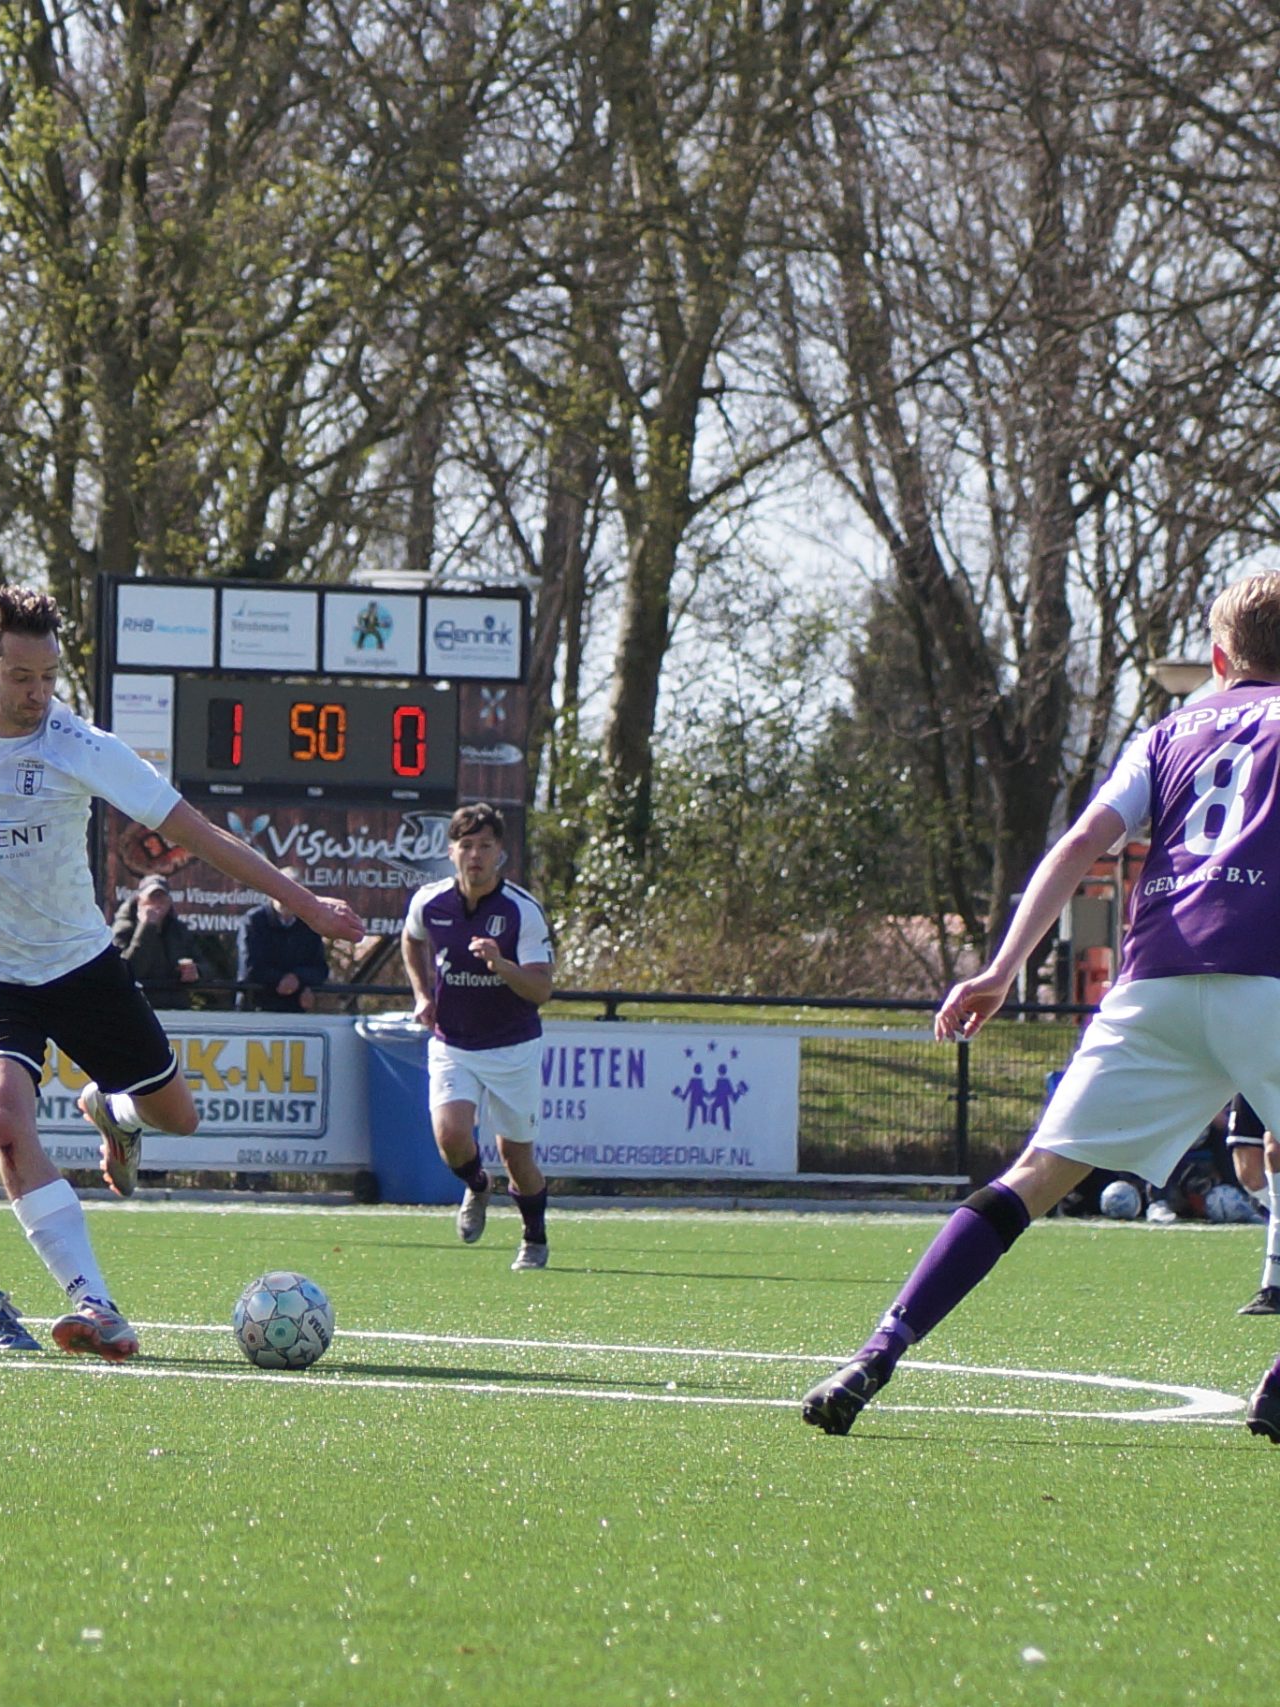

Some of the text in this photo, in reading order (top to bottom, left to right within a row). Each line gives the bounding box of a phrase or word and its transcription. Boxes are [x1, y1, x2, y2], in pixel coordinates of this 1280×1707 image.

[122, 617, 155, 633] RHB
[231, 703, 427, 777] 1 50 0
[1185, 741, 1254, 856] 8
[268, 822, 449, 866] Viswinkel
[1226, 867, 1267, 886] B.V.
